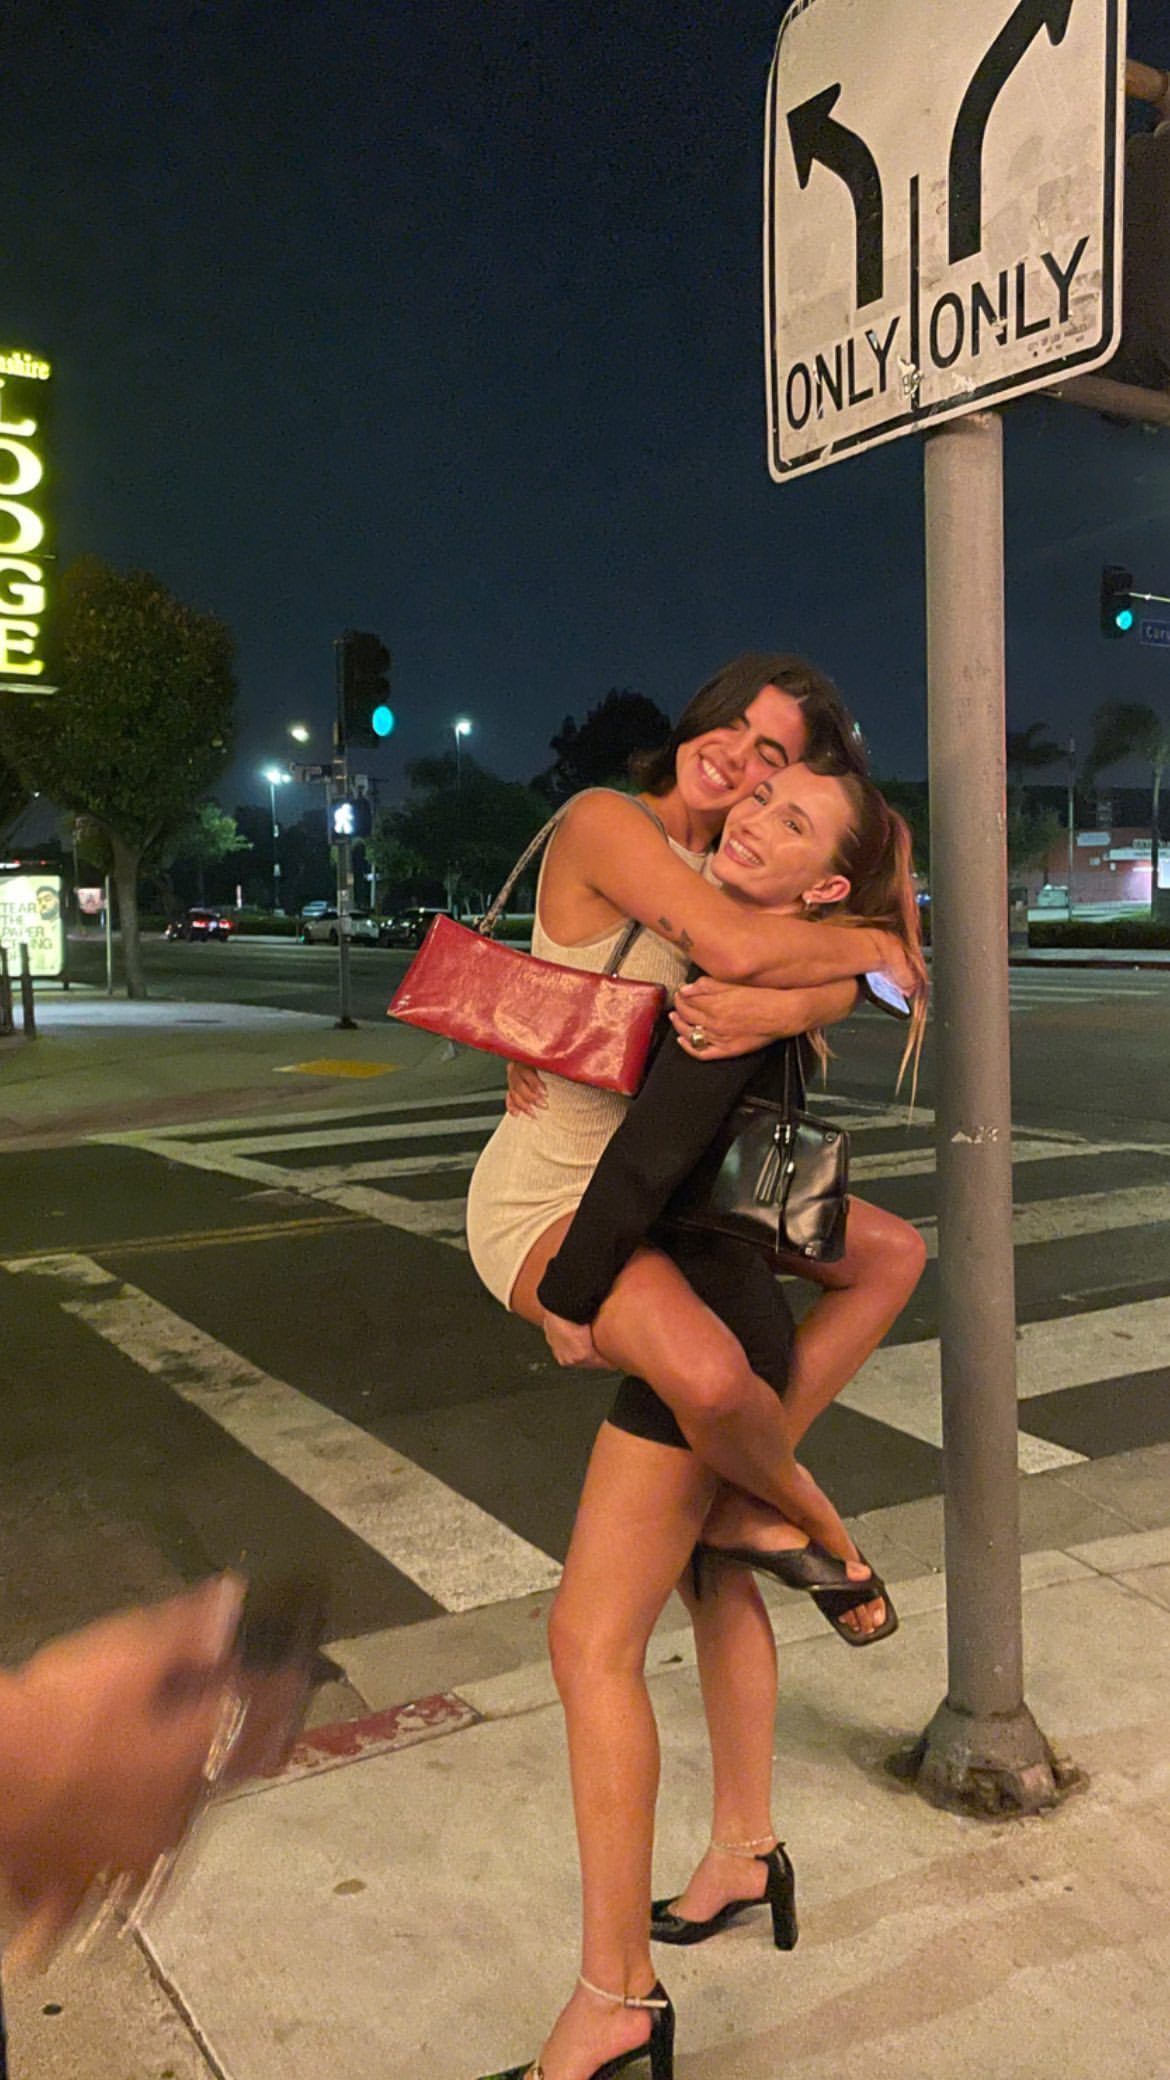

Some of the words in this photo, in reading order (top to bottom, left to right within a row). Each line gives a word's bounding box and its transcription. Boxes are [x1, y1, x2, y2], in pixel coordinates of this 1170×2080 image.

[929, 235, 1089, 369] ONLY
[786, 316, 900, 430] ONLY
[0, 902, 37, 913] TEAR
